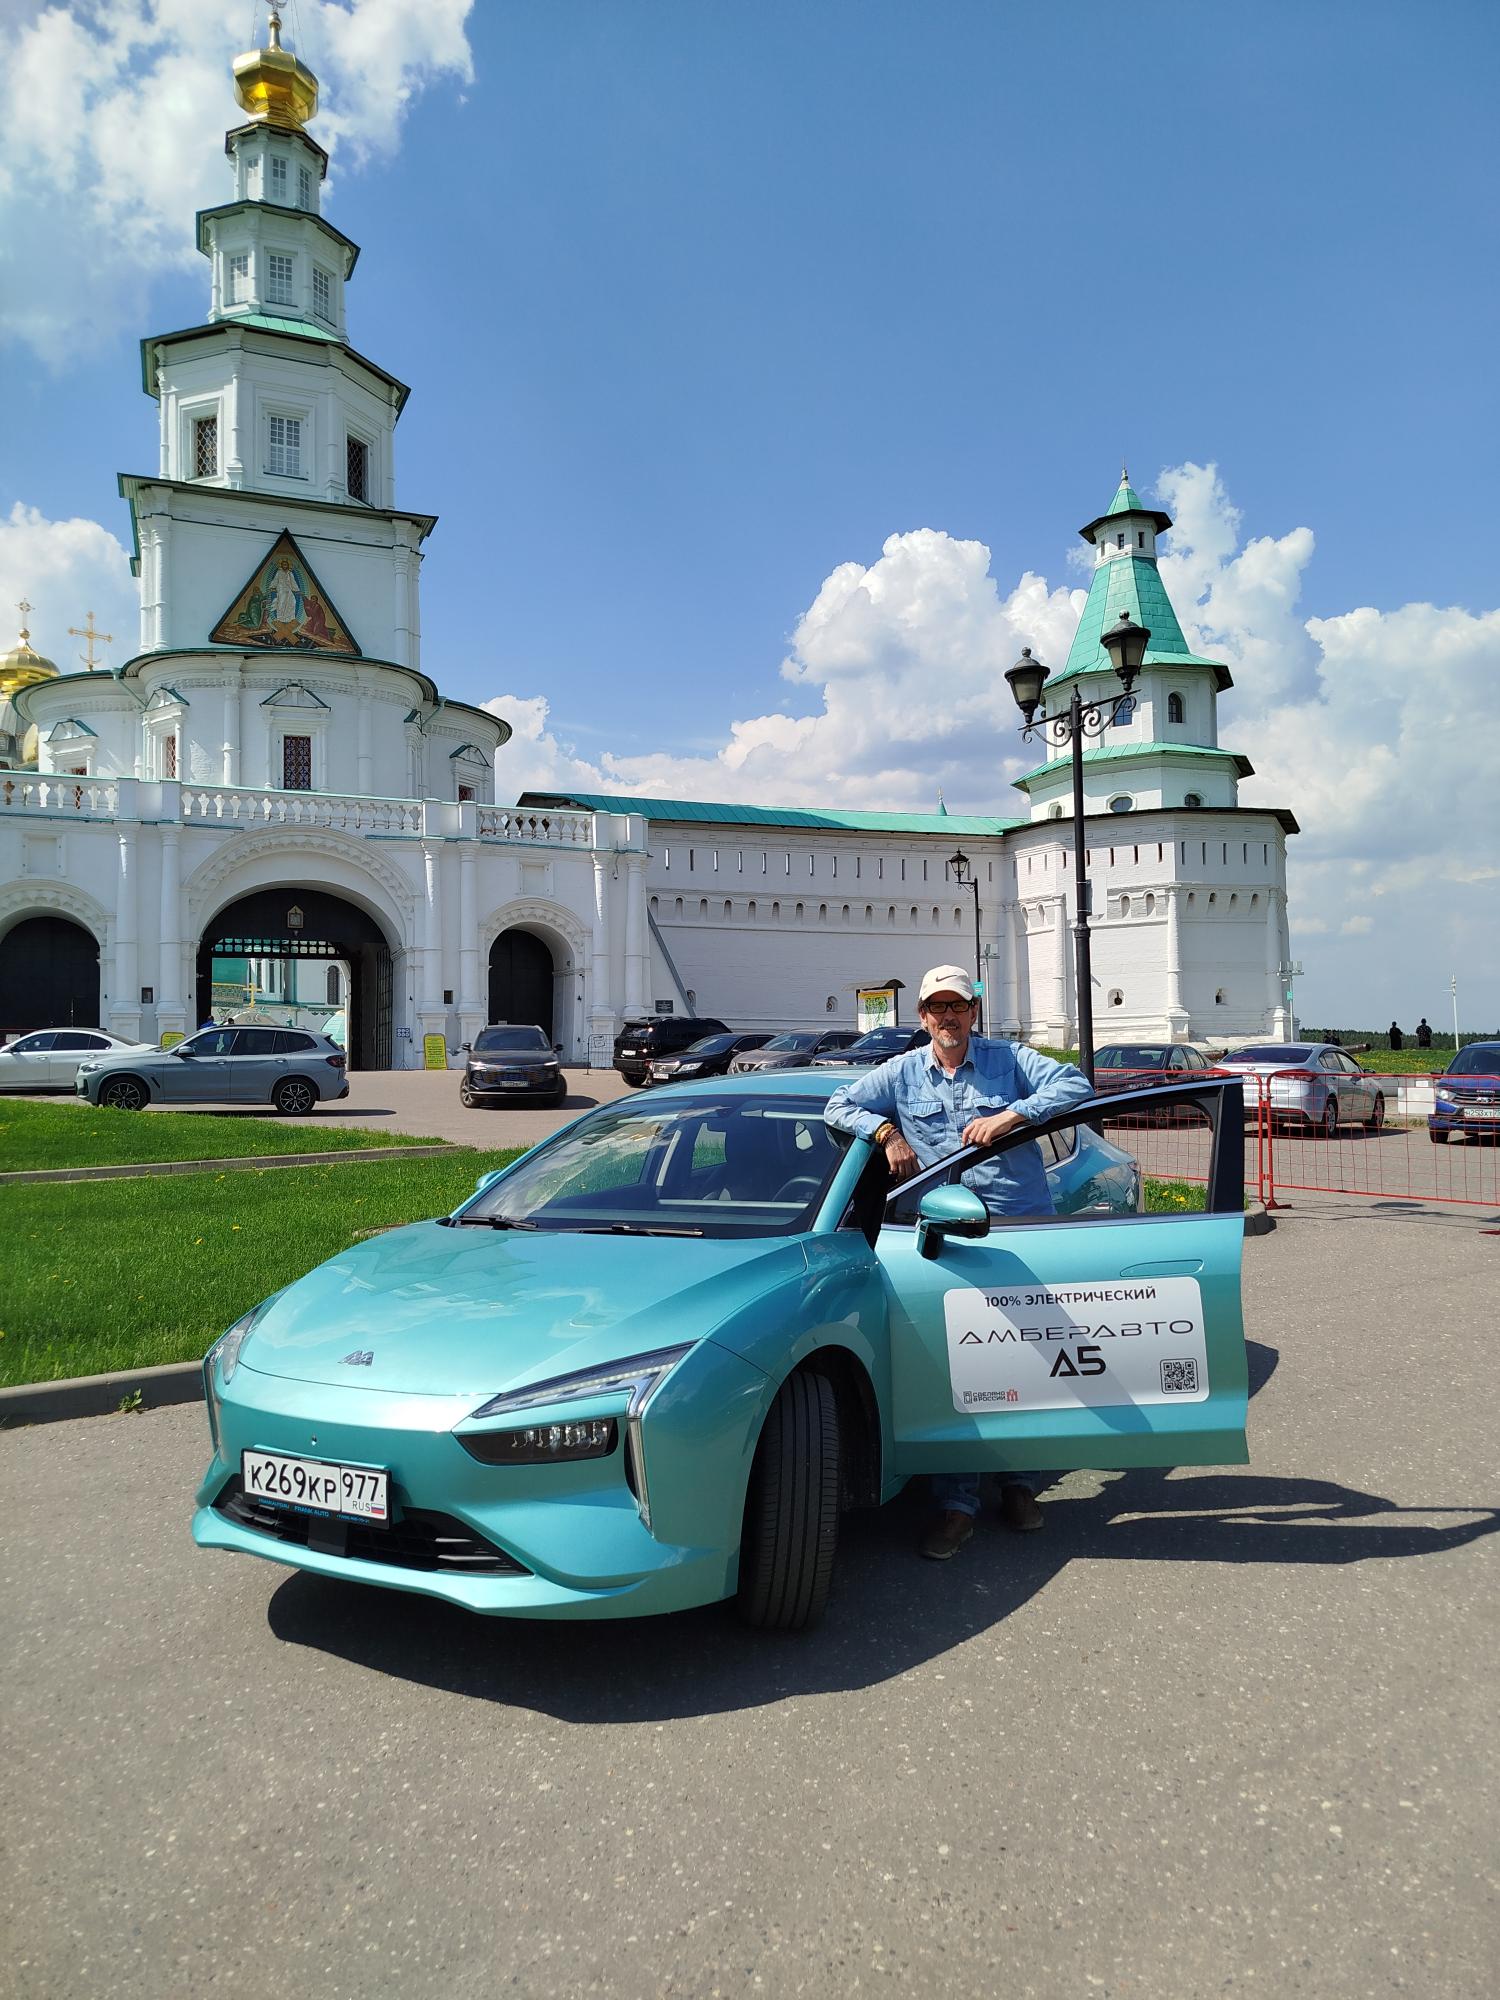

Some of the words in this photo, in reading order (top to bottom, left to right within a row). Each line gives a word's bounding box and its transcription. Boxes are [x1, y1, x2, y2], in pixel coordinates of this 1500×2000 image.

[985, 1295, 1021, 1308] 100%
[1024, 1285, 1157, 1306] ЭЛЕКТРИЧЕСКИЙ
[959, 1319, 1194, 1345] АМБЕРАВТО
[342, 1472, 379, 1501] 977
[352, 1500, 371, 1513] RUS
